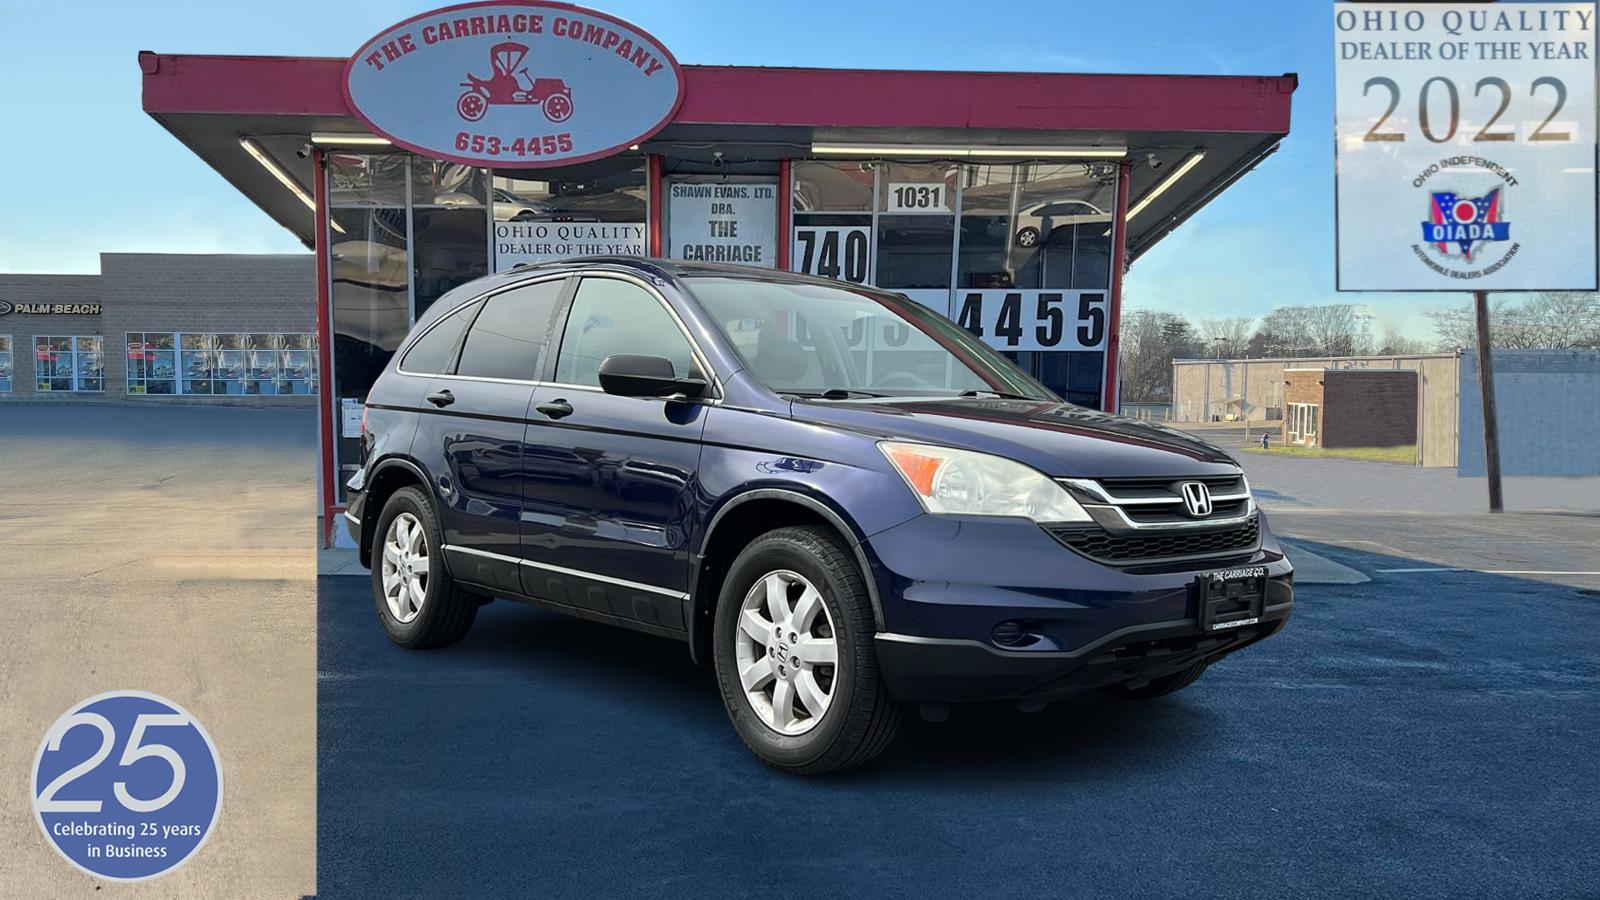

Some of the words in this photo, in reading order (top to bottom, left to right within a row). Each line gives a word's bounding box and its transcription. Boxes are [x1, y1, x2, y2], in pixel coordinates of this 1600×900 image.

[1336, 10, 1425, 31] OHIO
[1442, 10, 1592, 36] QUALITY
[366, 33, 416, 71] THE
[422, 15, 543, 45] CARRIAGE
[553, 17, 664, 77] COMPANY
[1341, 42, 1433, 60] DEALER
[1439, 42, 1469, 60] OF
[1475, 42, 1522, 60] THE
[1528, 42, 1589, 60] YEAR
[1363, 76, 1571, 143] 2022
[455, 132, 573, 156] 653-4455
[1413, 164, 1439, 188] OHIO
[1440, 156, 1519, 187] INDEPENDENT
[673, 186, 712, 199] SHAWN
[754, 187, 775, 200] LTD.
[893, 187, 940, 208] 1031
[711, 203, 736, 215] DBA.
[497, 226, 548, 239] OHIO
[557, 226, 643, 241] QUALITY
[708, 221, 738, 238] THE
[1432, 224, 1495, 241] OIADA
[500, 244, 551, 255] DEALER
[555, 244, 573, 255] OF
[576, 244, 604, 255] THE
[607, 244, 641, 255] YEAR
[683, 245, 762, 263] CARRIAGE
[797, 230, 868, 284] 740
[1450, 270, 1482, 279] DEALERS
[1483, 242, 1520, 276] ASSOCIATION
[14, 304, 51, 314] PALM
[54, 304, 100, 314] BEACH
[958, 293, 1105, 347] 4455
[1213, 571, 1225, 581] THE
[1224, 568, 1254, 580] CARRIAGE
